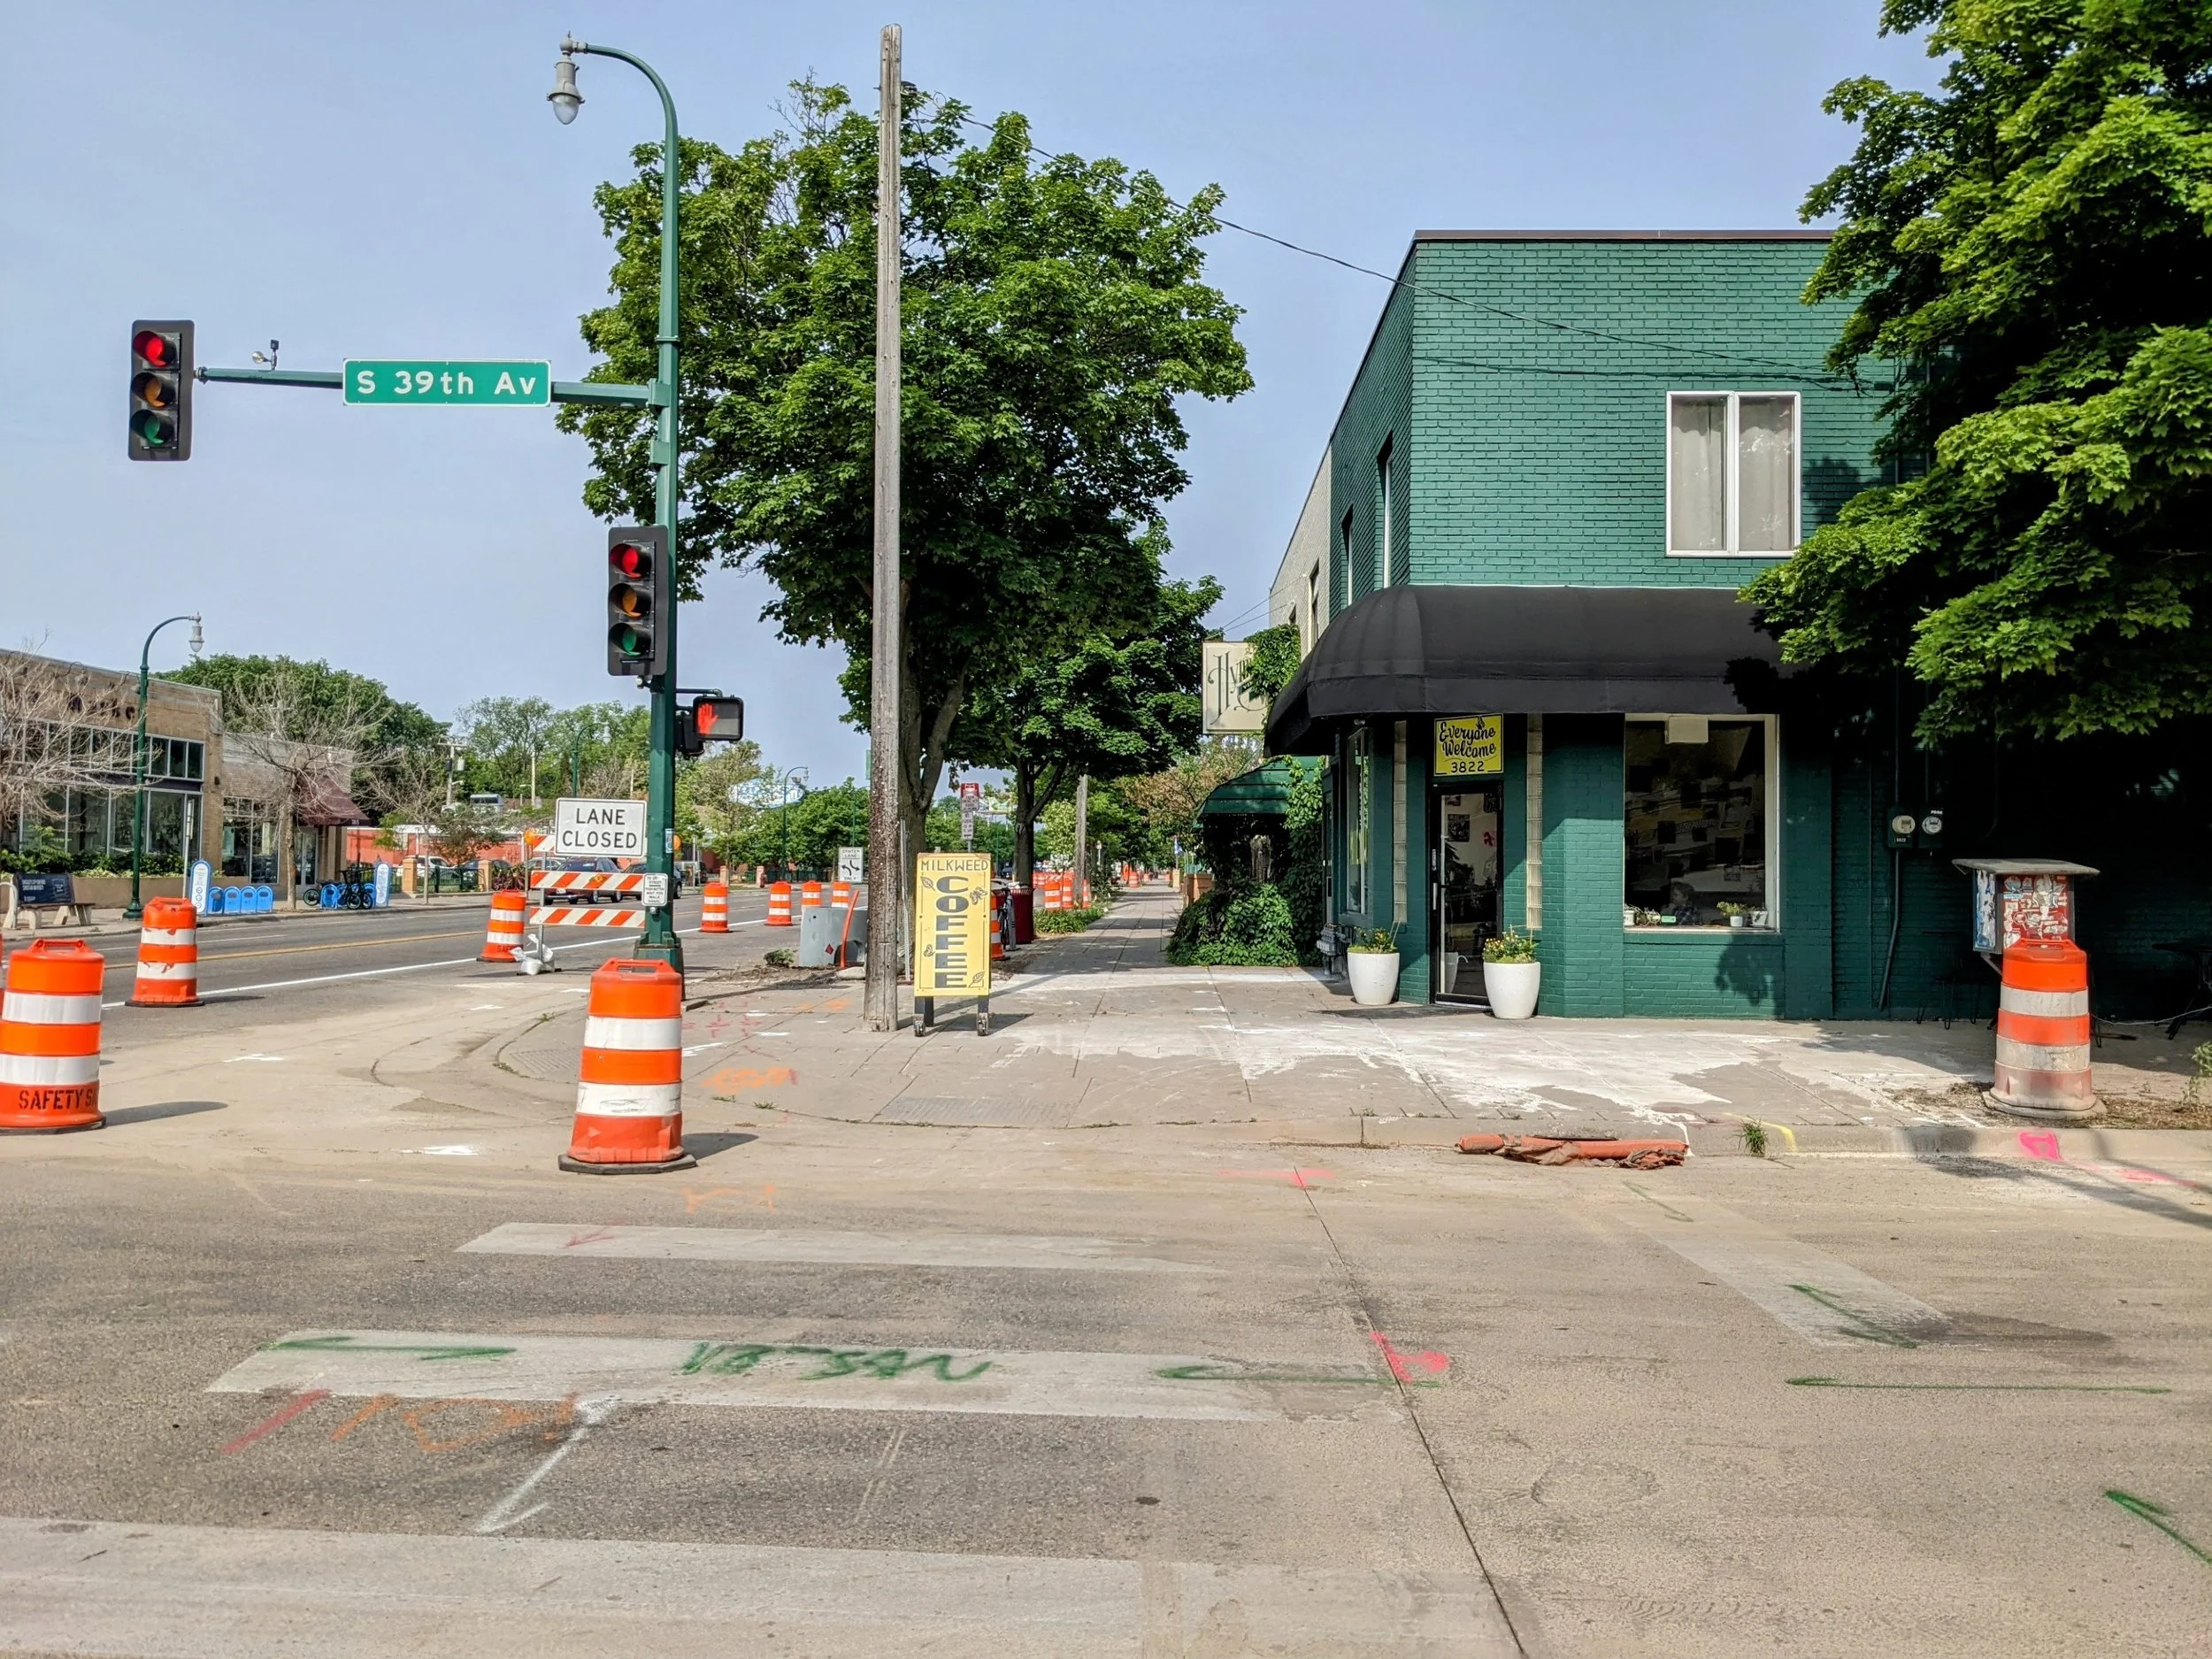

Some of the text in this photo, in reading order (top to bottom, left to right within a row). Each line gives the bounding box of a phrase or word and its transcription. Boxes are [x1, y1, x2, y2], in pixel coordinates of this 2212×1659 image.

[357, 370, 537, 395] S 39th Av
[1439, 721, 1496, 746] Everyone
[1442, 740, 1497, 758] Welcome
[1451, 761, 1485, 773] 3822
[576, 808, 626, 826] LANE
[562, 830, 637, 849] CLOSED
[920, 859, 989, 872] MILKWEED
[934, 875, 970, 988] COFFEE
[19, 1089, 84, 1110] SAFETY
